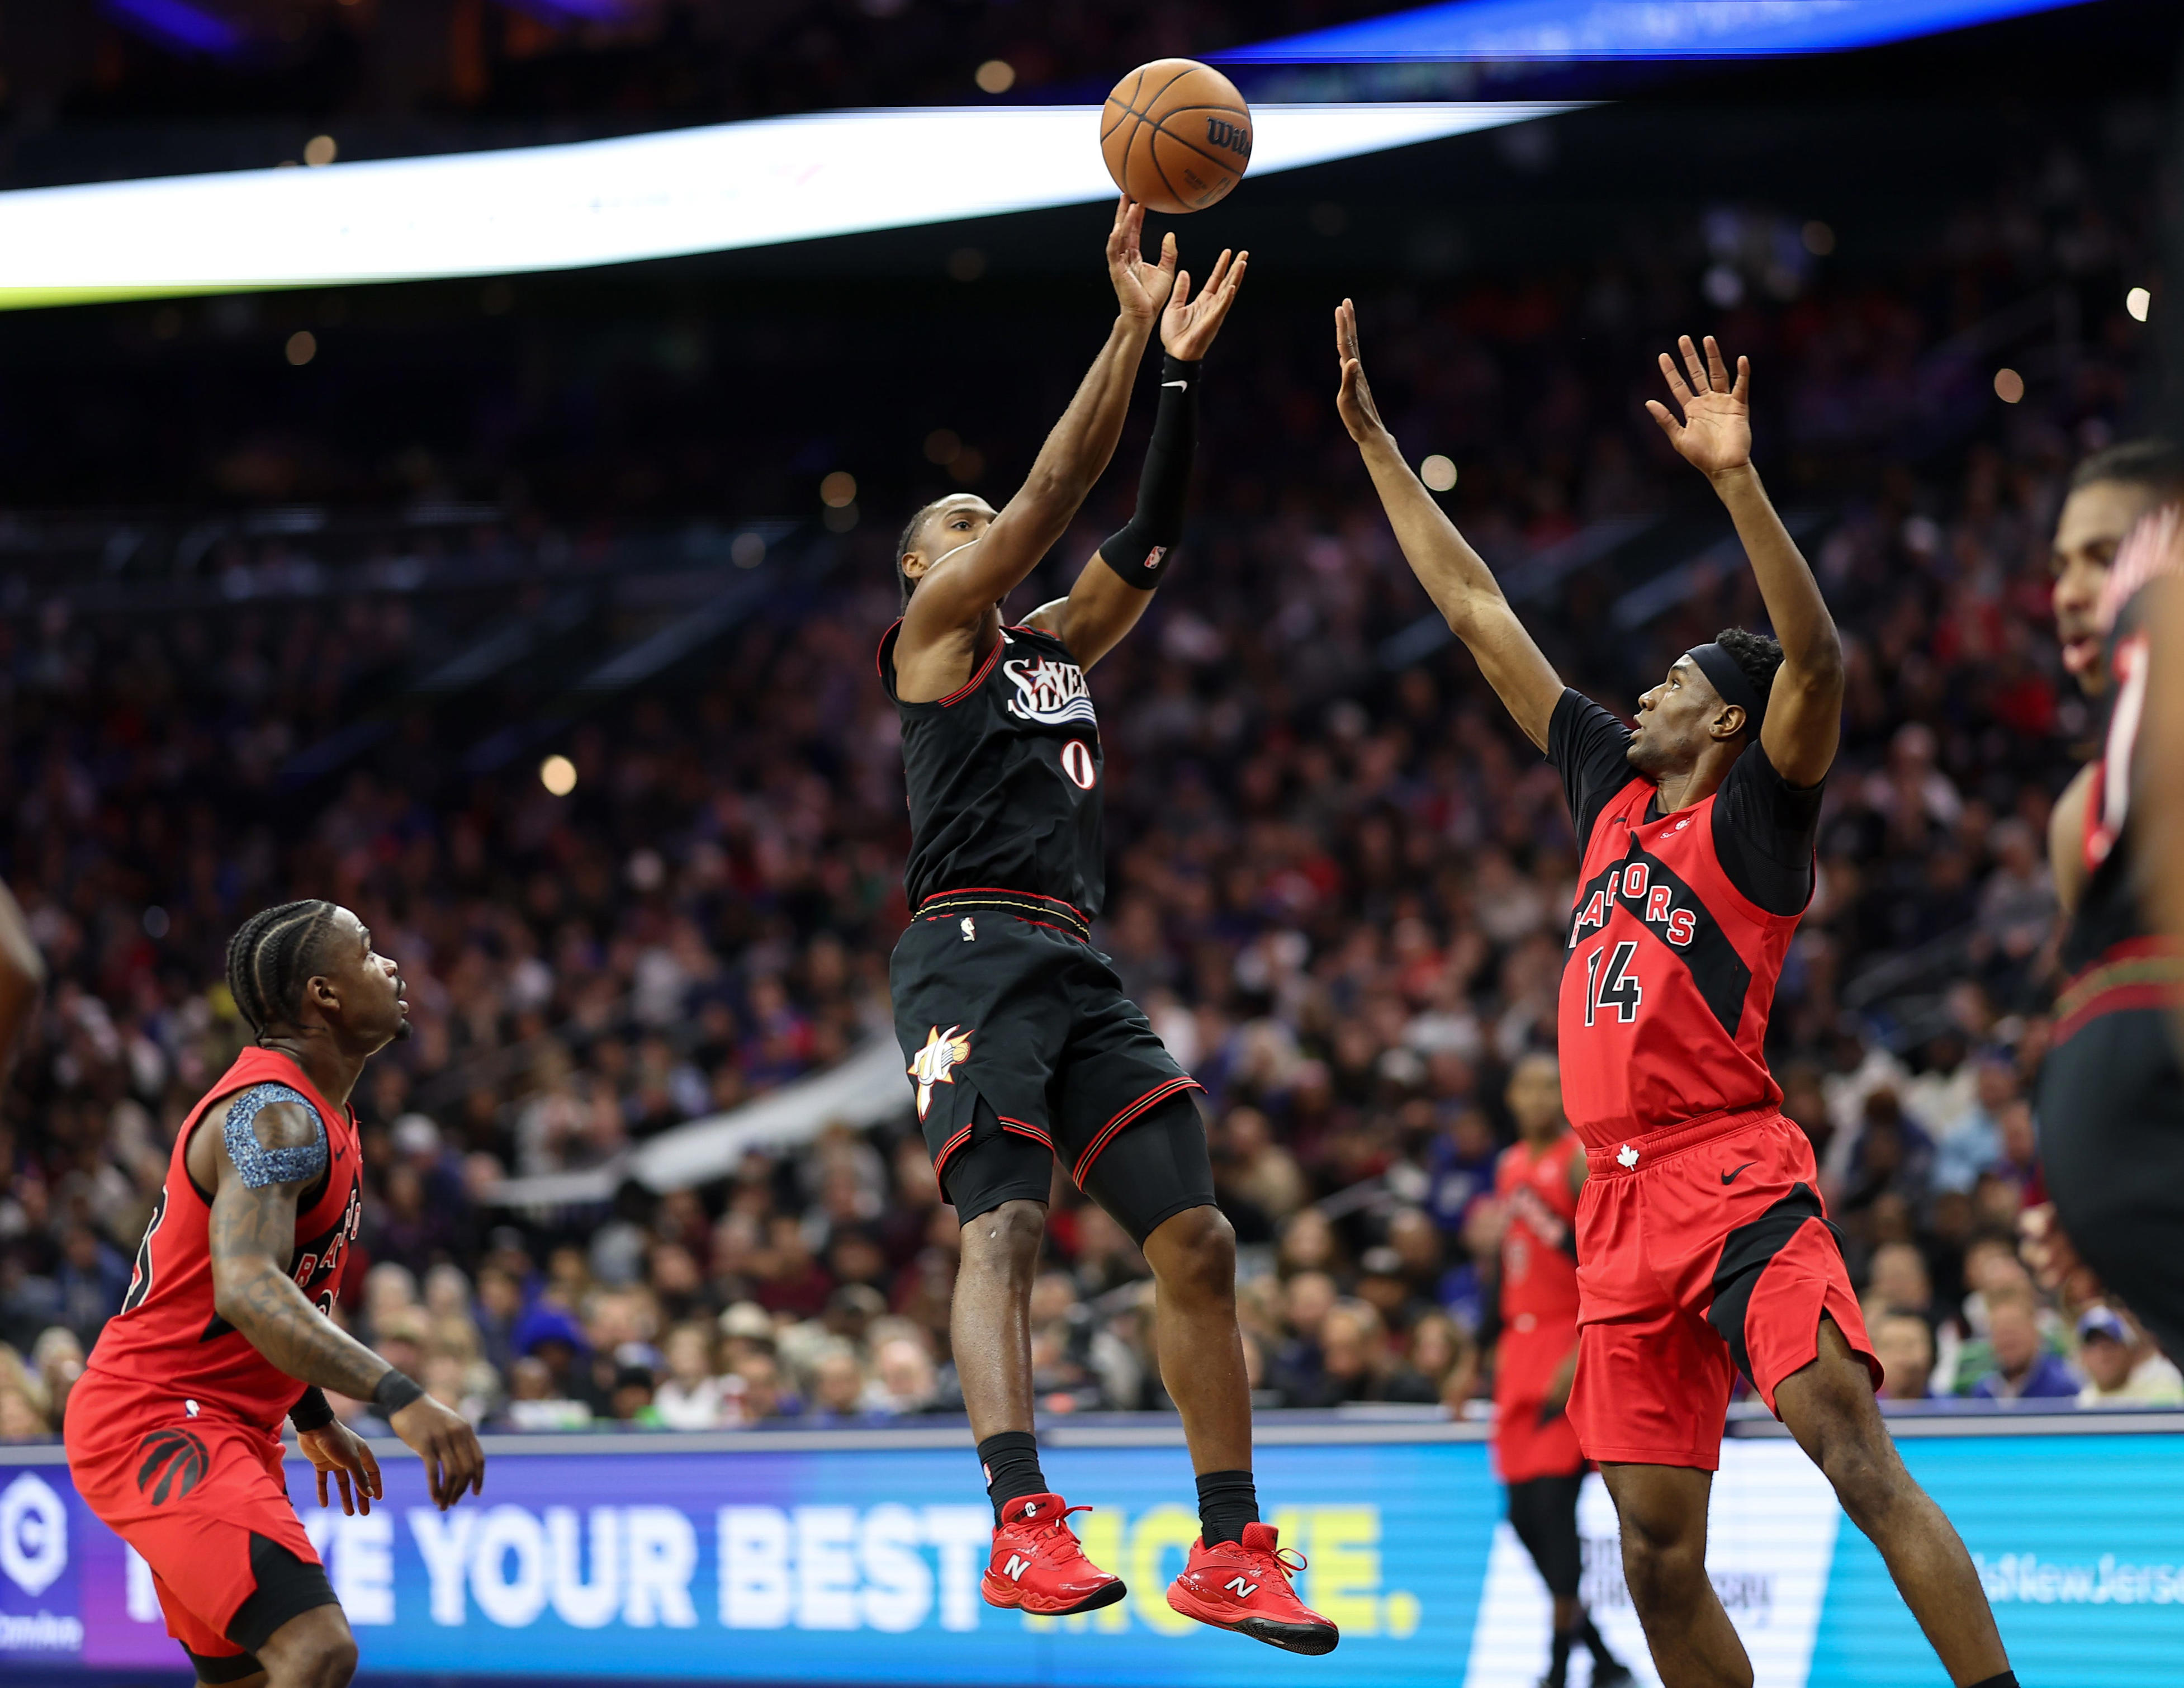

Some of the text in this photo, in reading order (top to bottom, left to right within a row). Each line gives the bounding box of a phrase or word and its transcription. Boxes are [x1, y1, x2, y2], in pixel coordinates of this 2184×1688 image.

[1060, 738, 1096, 790] 0
[1584, 940, 1642, 1027] 14
[407, 1503, 699, 1628] YOUR
[716, 1503, 990, 1633] BEST
[1002, 1553, 1032, 1582] N
[1224, 1576, 1259, 1599] N
